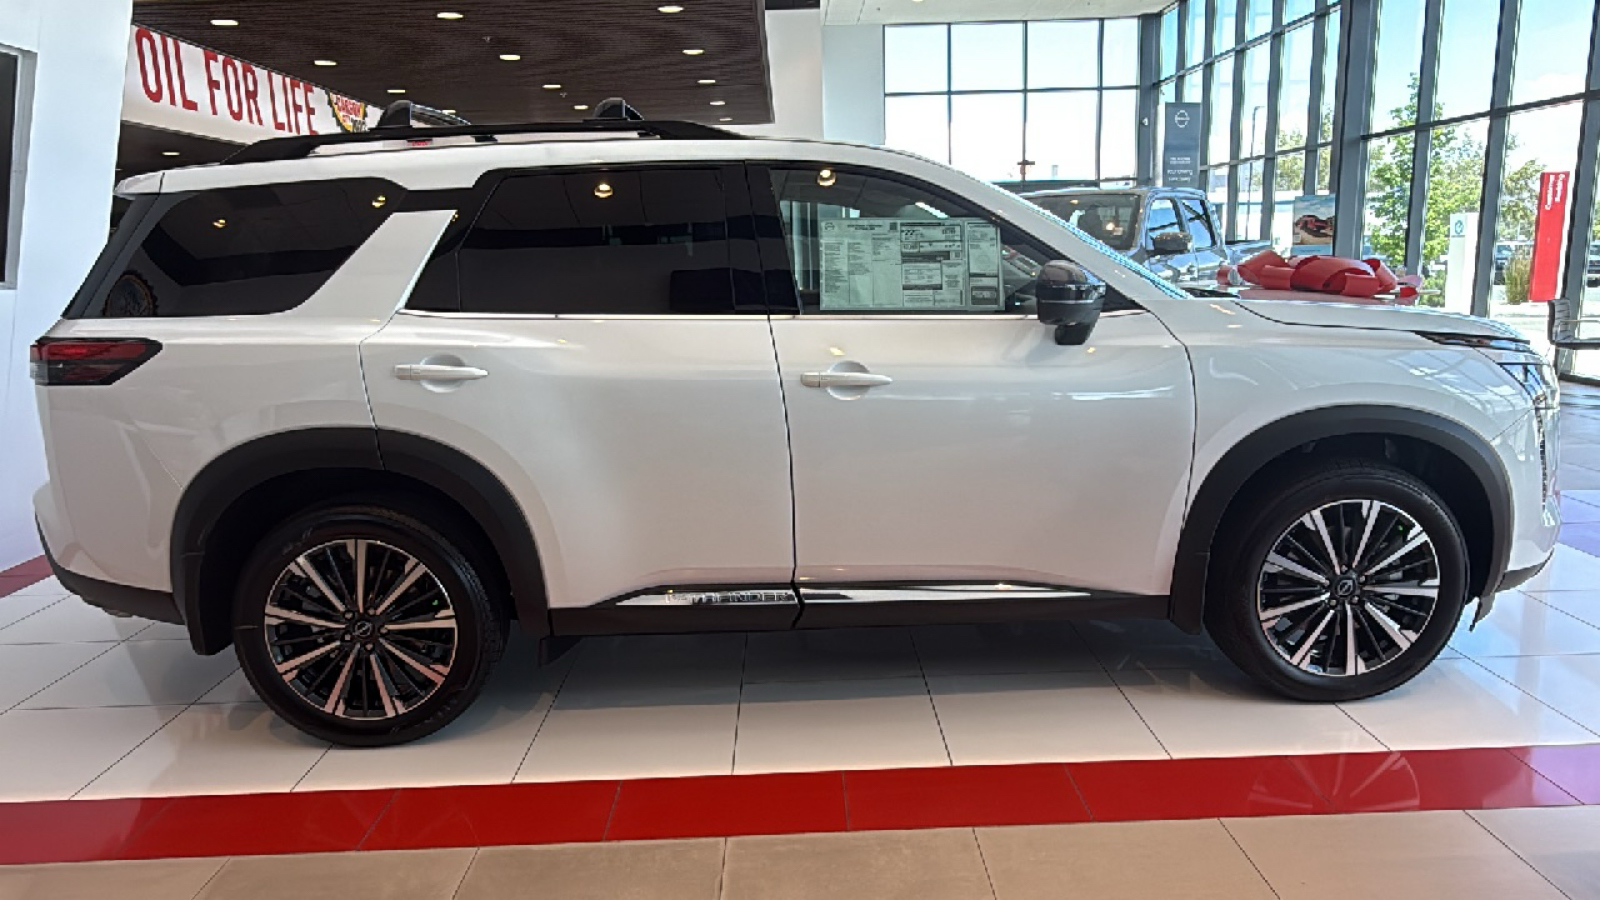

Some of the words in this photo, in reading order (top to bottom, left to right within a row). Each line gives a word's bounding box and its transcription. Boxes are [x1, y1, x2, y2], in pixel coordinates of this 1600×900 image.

[135, 27, 198, 111] OIL
[203, 49, 263, 126] FOR
[267, 69, 319, 135] LIFE
